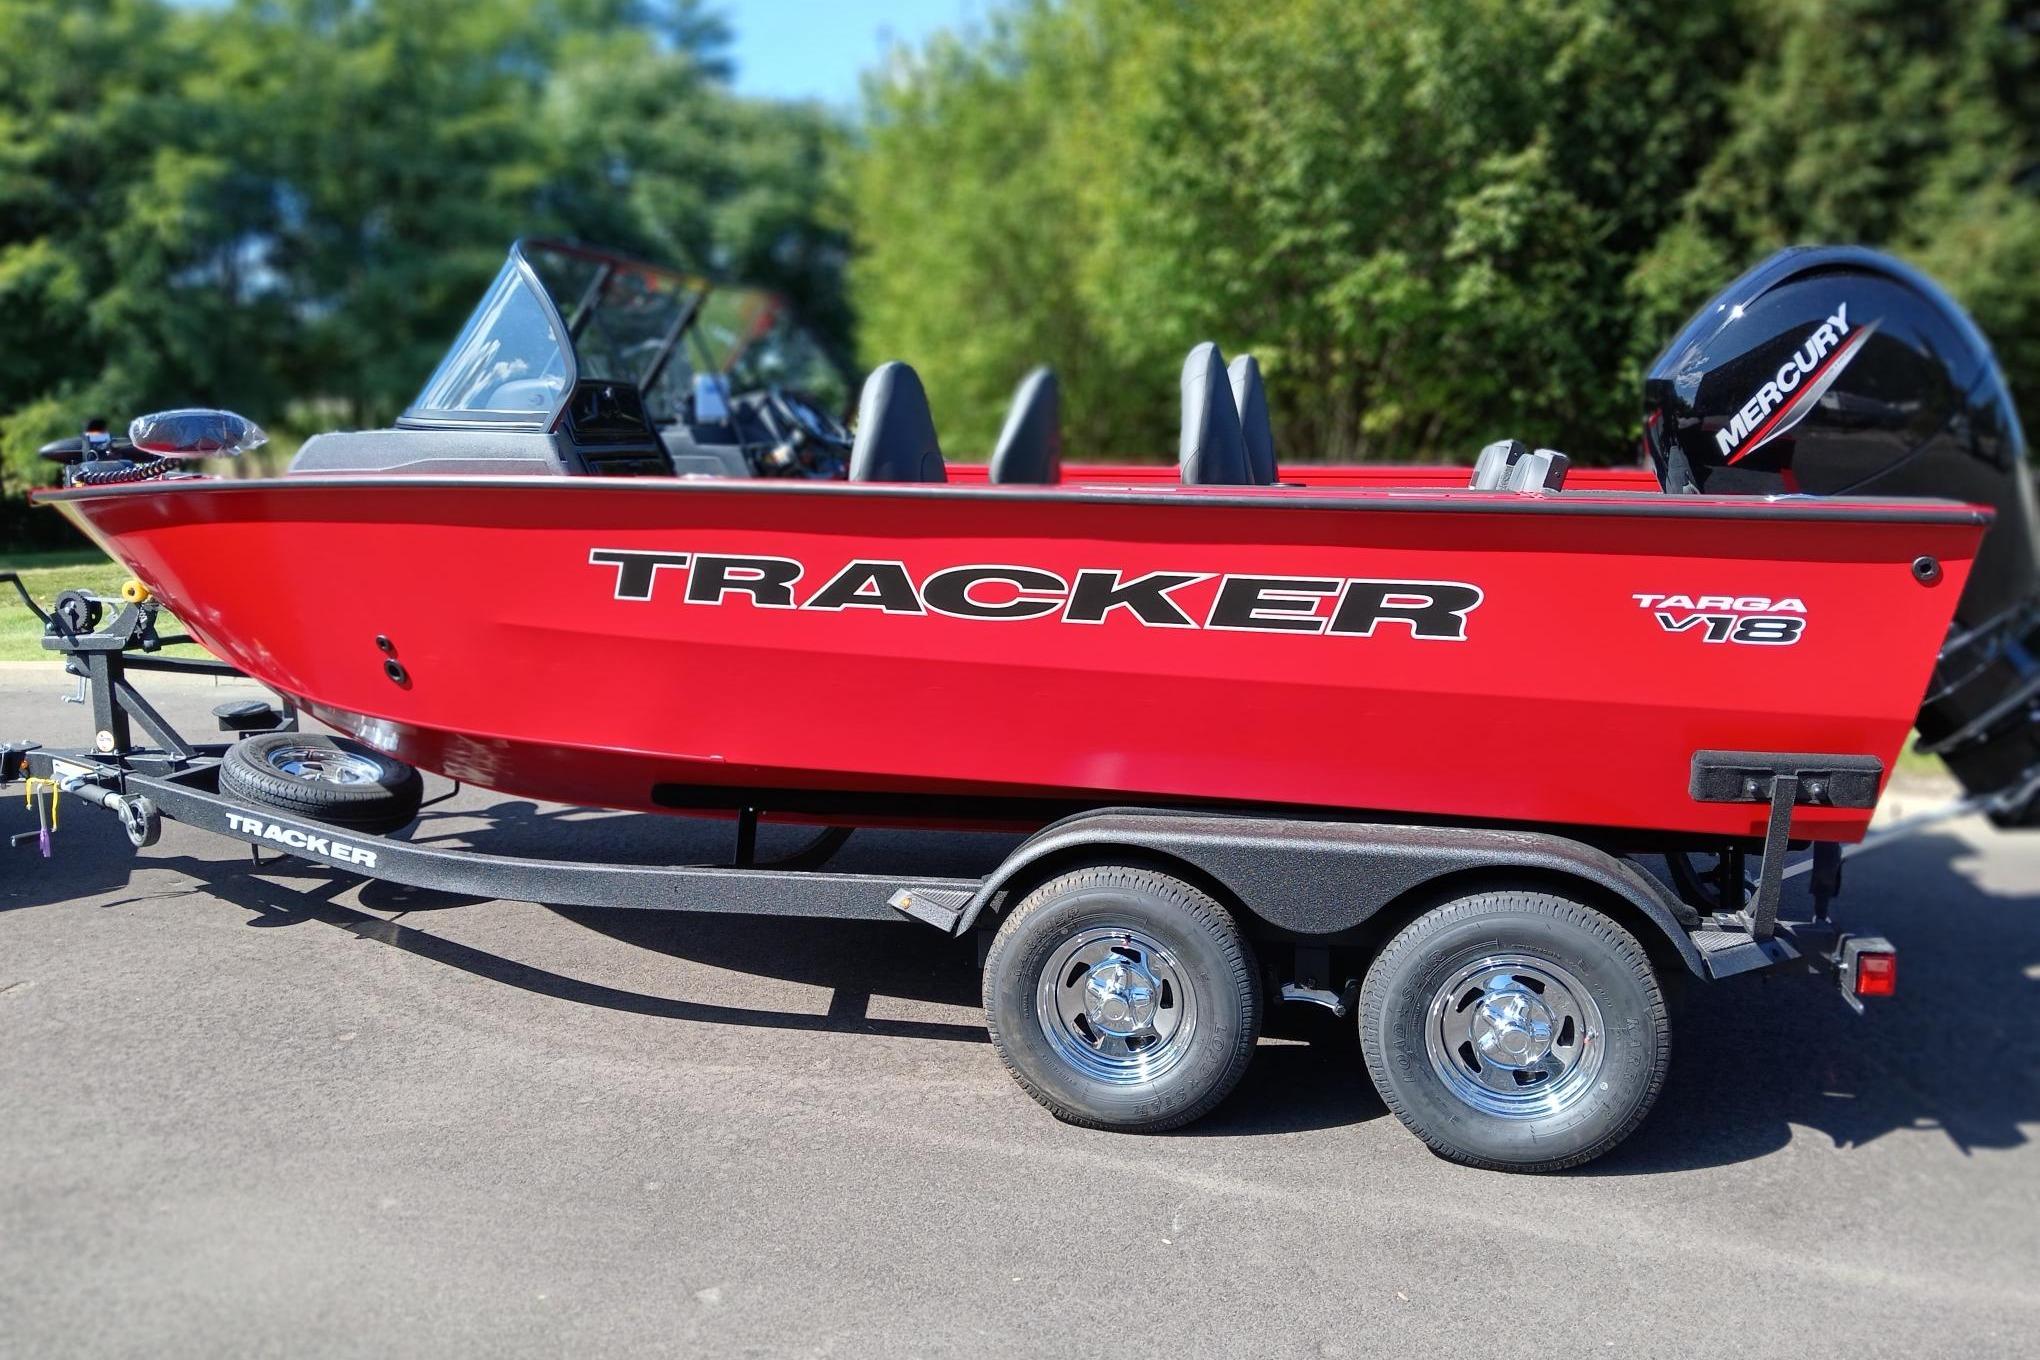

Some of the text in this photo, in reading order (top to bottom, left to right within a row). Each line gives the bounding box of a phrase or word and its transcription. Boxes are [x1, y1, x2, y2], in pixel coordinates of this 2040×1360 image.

[1715, 301, 1849, 456] MERCURY
[588, 548, 1484, 641] TRACKER
[1632, 594, 1807, 613] TARGA
[1654, 612, 1806, 646] V18
[225, 812, 377, 868] TRACKER
